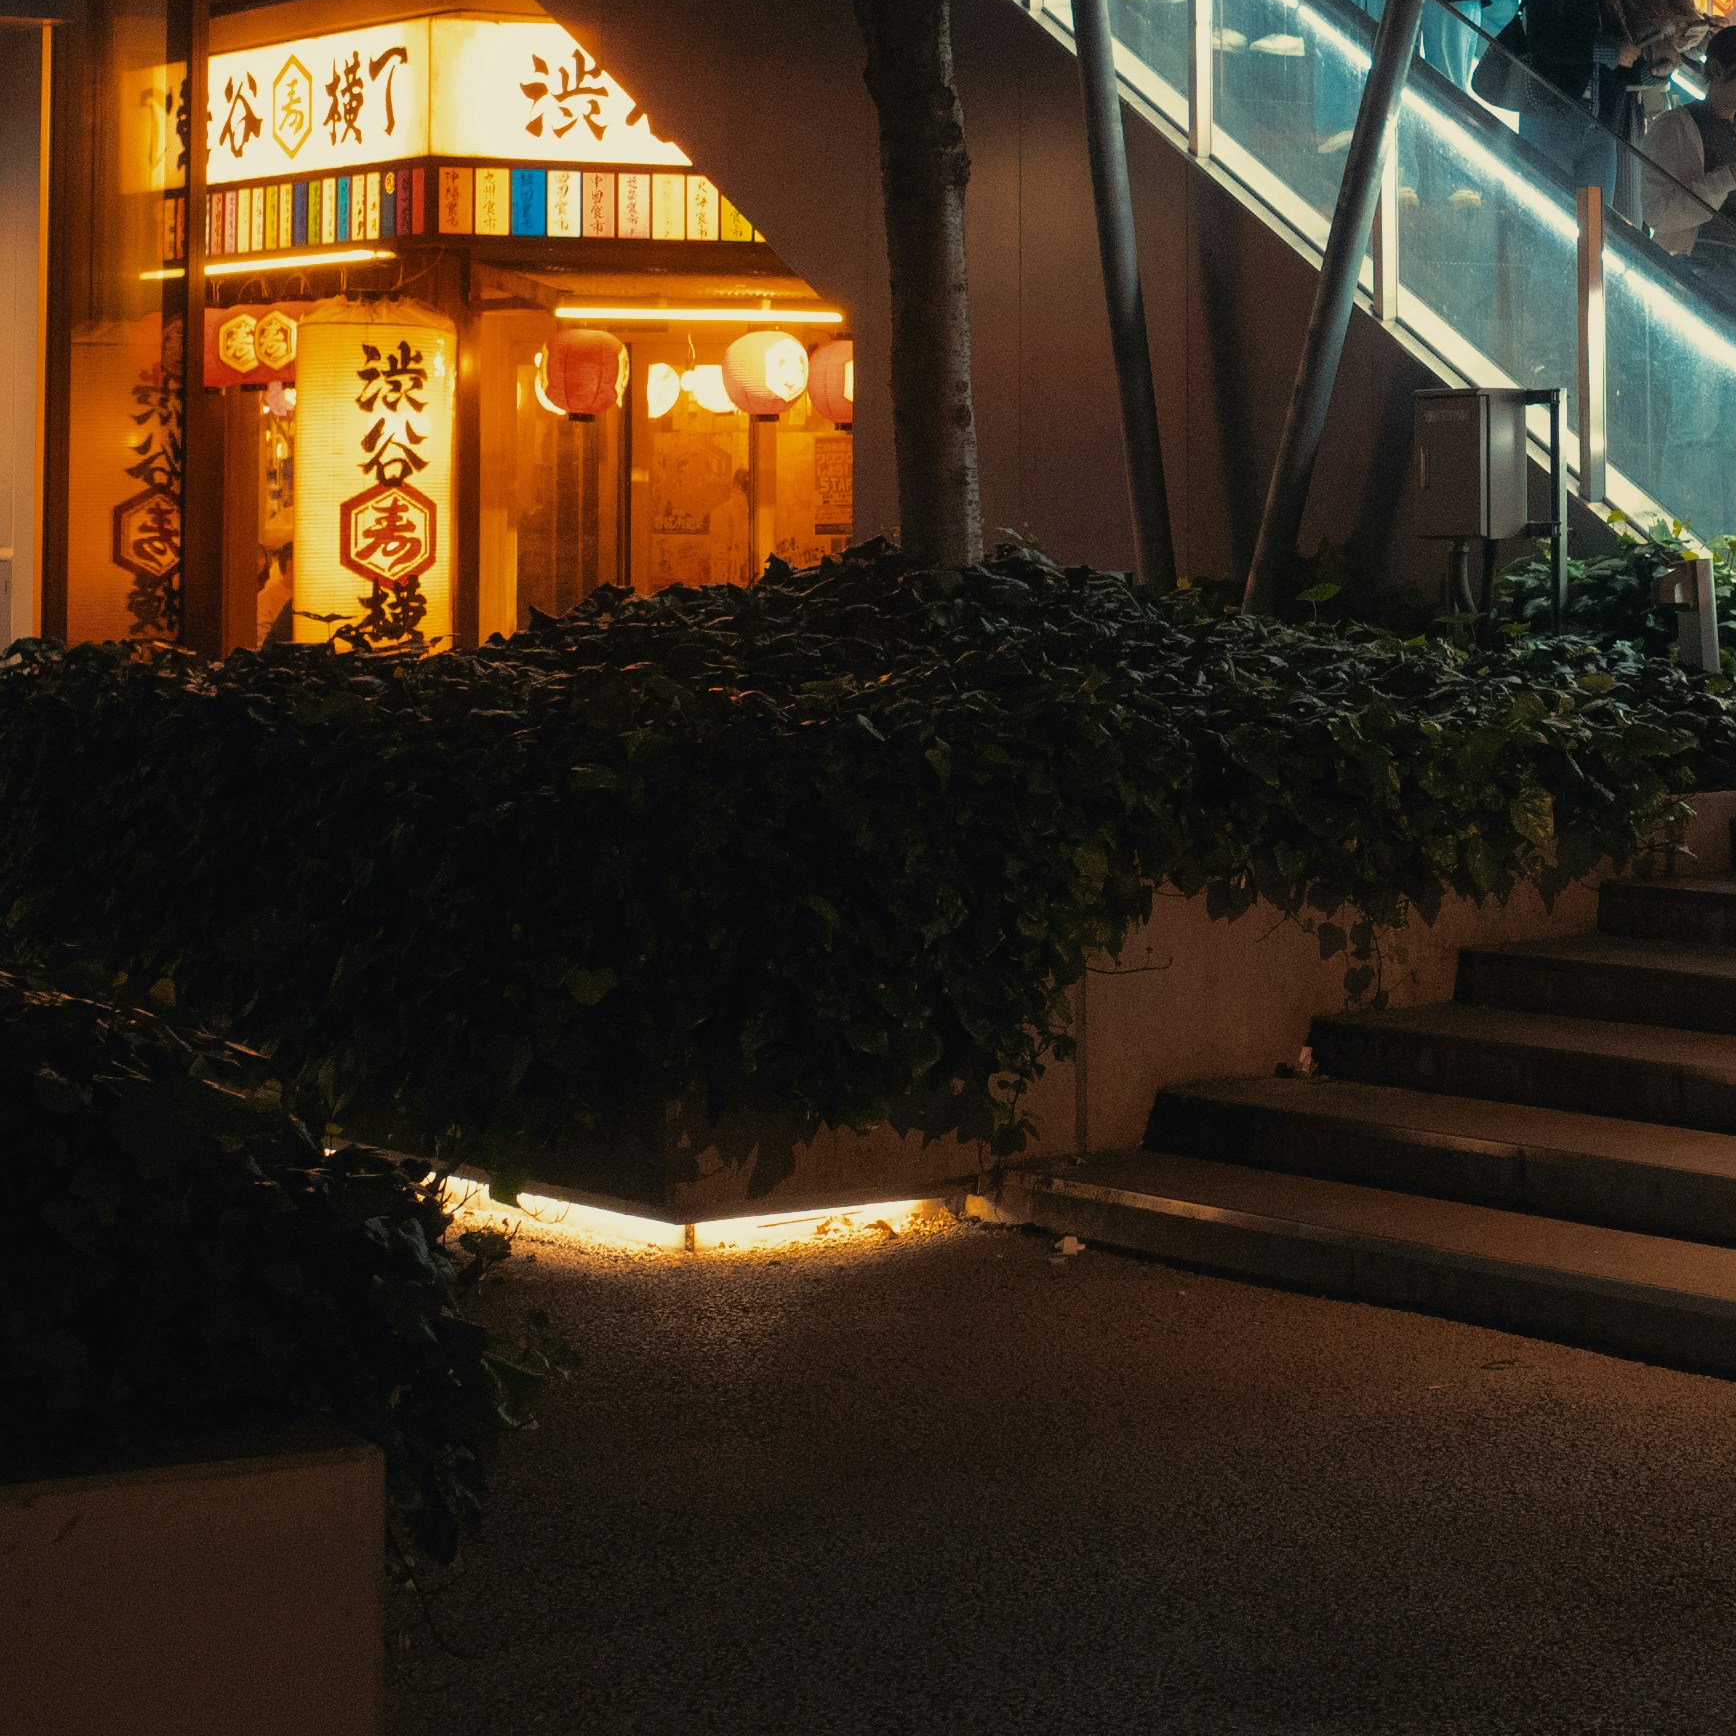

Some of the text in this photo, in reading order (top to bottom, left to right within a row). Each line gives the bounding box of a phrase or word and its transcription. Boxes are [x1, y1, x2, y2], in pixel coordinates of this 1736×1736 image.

[208, 47, 408, 159] 谷寿横丁
[519, 49, 668, 143] 渋
